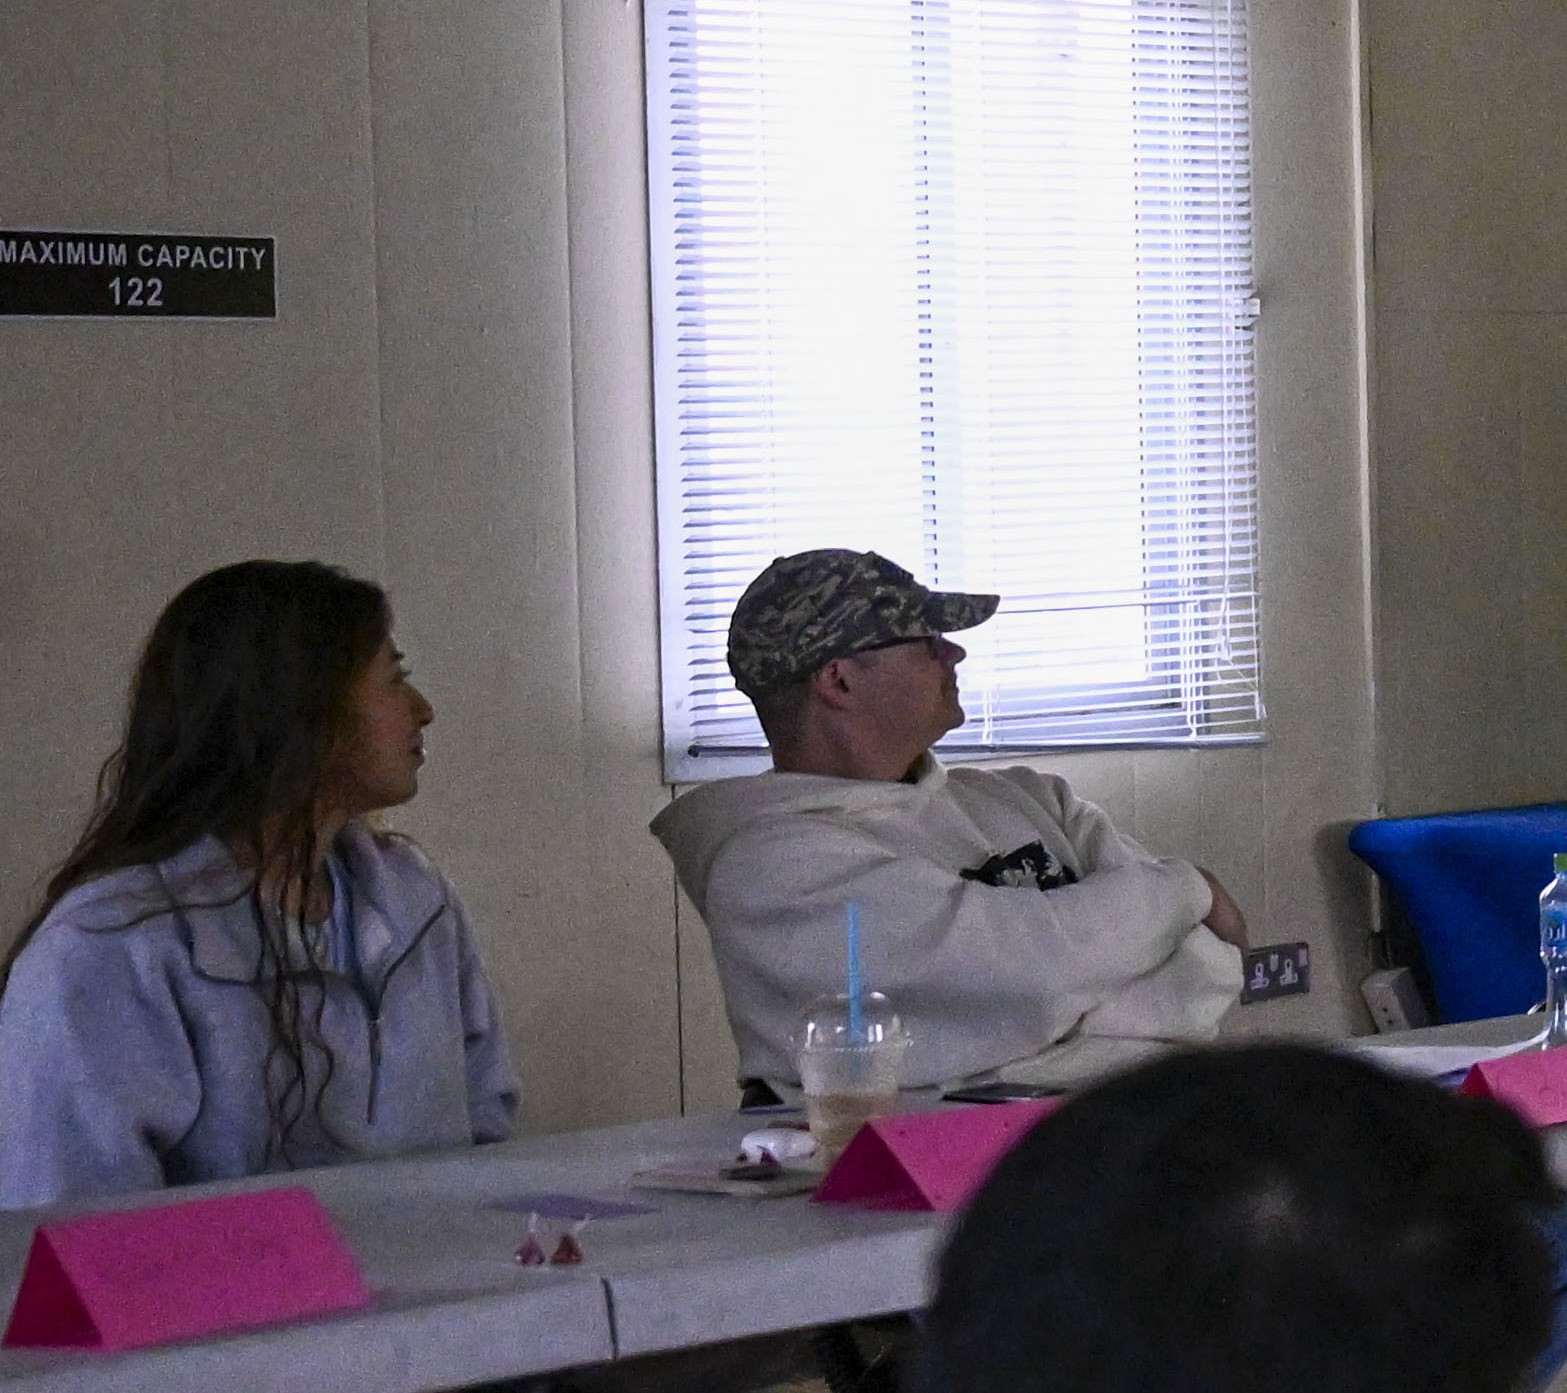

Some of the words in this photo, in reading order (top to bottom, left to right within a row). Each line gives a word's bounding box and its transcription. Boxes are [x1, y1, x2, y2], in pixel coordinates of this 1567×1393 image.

[0, 240, 127, 267] MAXIMUM
[138, 244, 266, 270] CAPACITY
[108, 276, 164, 307] 122
